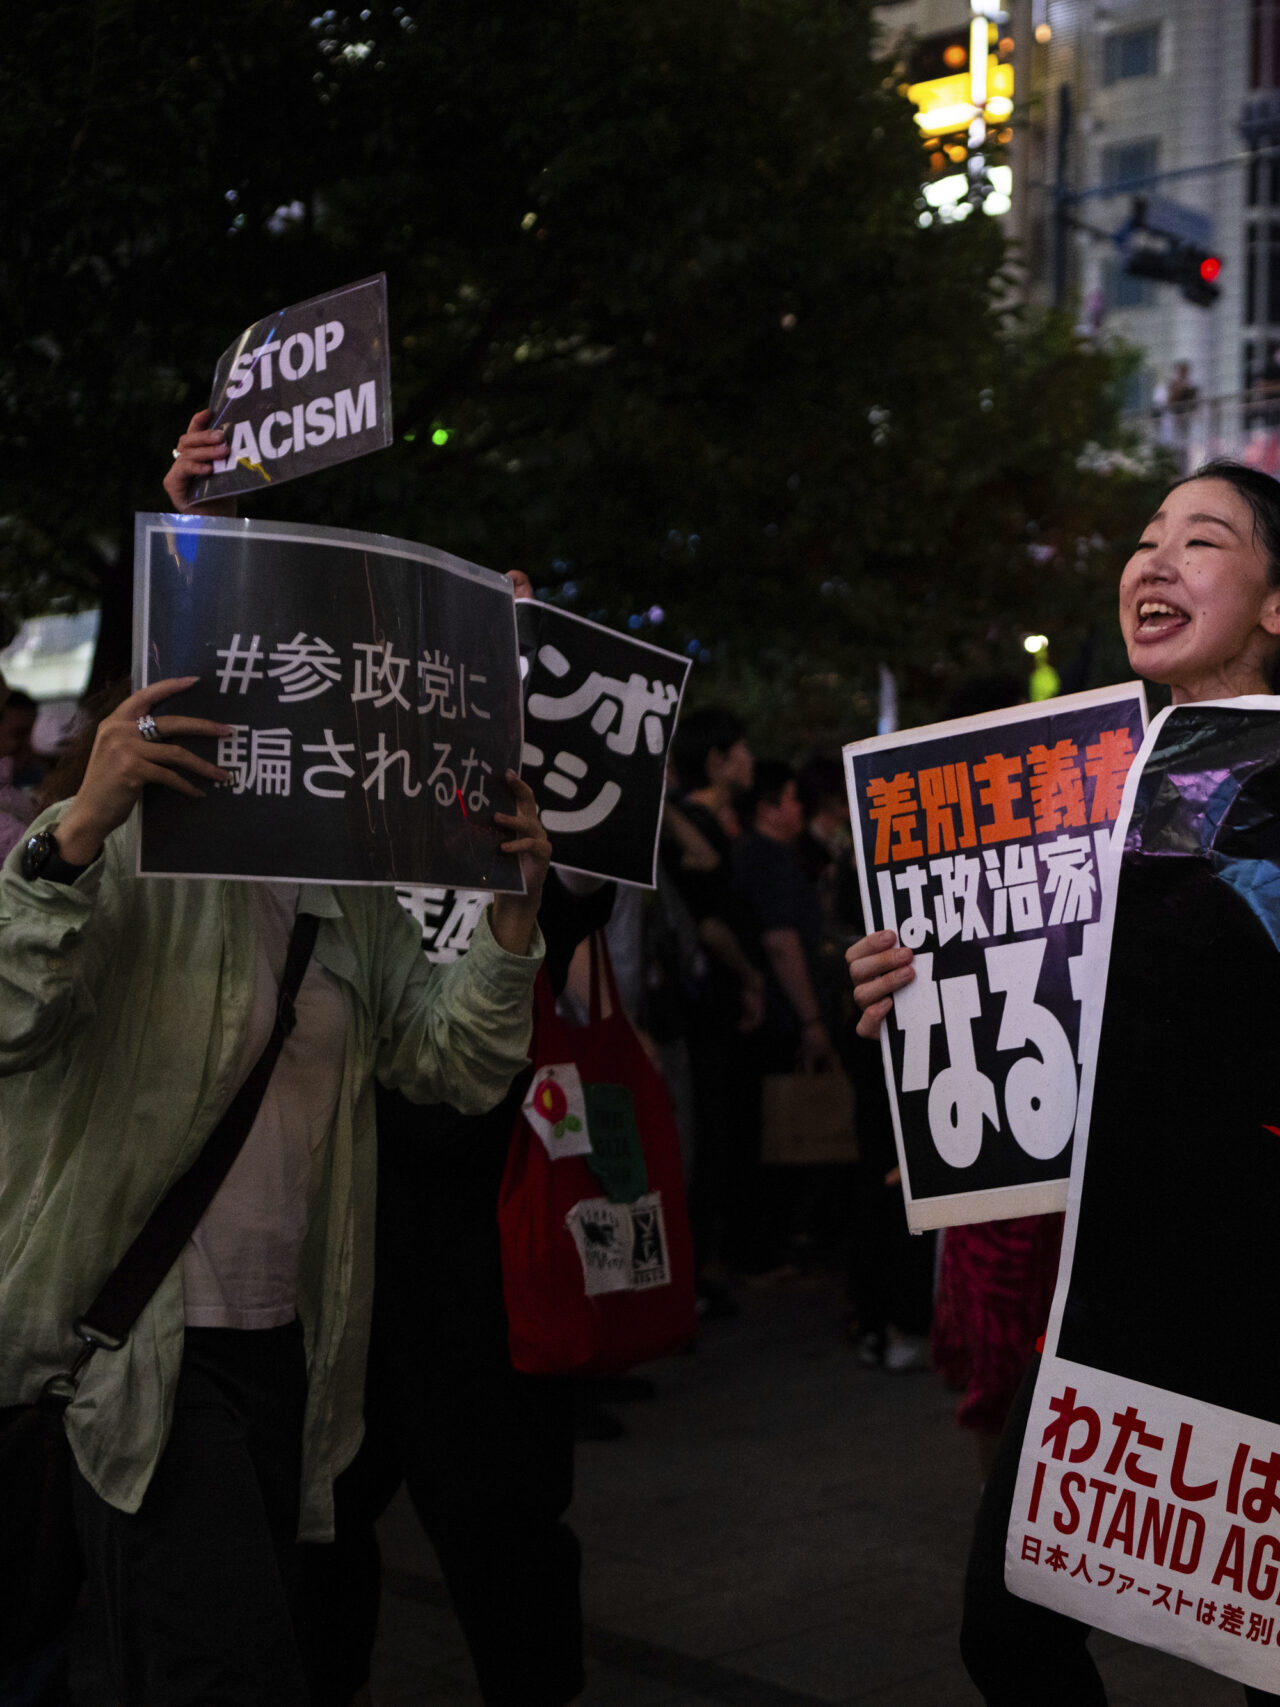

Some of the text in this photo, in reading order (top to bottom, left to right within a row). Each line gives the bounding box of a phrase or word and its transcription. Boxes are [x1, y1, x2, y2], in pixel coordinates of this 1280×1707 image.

[226, 320, 345, 399] STOP
[213, 381, 378, 474] ACISM
[215, 632, 491, 720] #参政党に
[519, 643, 679, 755] ンボ
[213, 723, 493, 812] 騙されるな
[866, 727, 1137, 865] 差別主義者
[876, 828, 1112, 949] は政治家
[893, 922, 1109, 1168] なる
[1027, 1463, 1047, 1523] I
[1053, 1471, 1206, 1575] STAND
